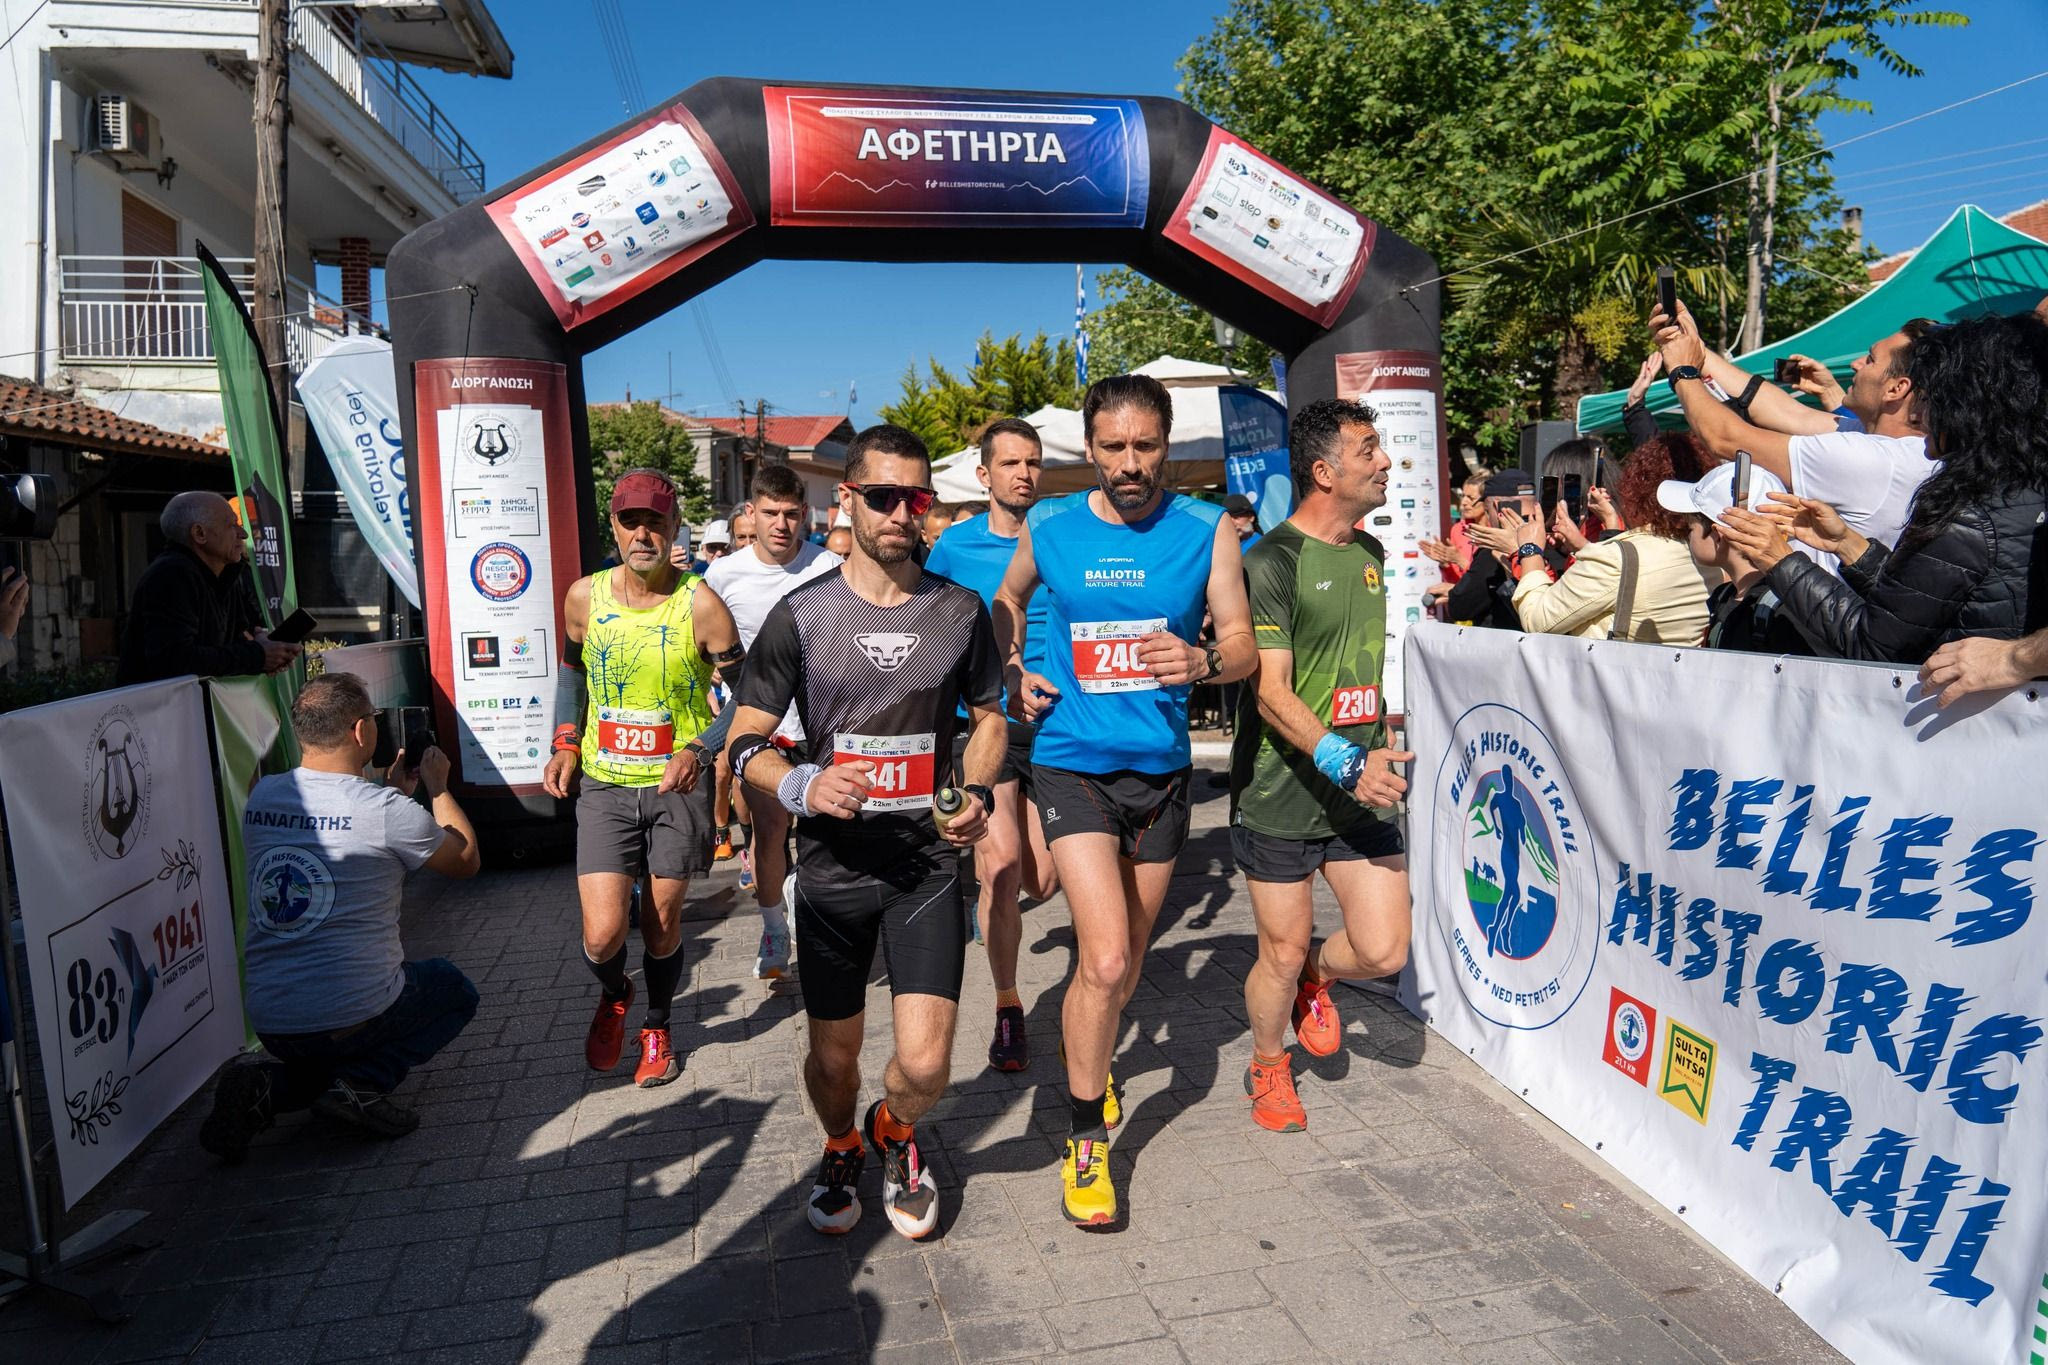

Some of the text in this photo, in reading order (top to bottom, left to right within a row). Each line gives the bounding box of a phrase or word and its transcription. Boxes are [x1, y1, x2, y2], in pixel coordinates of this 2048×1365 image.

[857, 127, 1068, 163] ΑΦΕΤΗΡΙΑ
[939, 181, 1006, 190] BELLESHISTORICTRAIL
[1239, 199, 1262, 217] step
[451, 376, 533, 390] ΔΙΟΡΓΑΝΩΣΗ
[1371, 366, 1430, 377] ΔΙΟΡΓΑΝΩΣΗ
[1393, 435, 1417, 444] CTP
[501, 505, 536, 513] ΣΙΝΤΙΚΗΣ
[1085, 570, 1145, 580] BALIOTIS
[493, 590, 523, 602] PROTECTION
[468, 700, 486, 708] ΕΡΤ
[502, 698, 521, 706] ΕΡΤ
[1337, 688, 1376, 719] 230
[615, 727, 656, 752] 329
[1450, 730, 1579, 855] BELLES HISTORIC TRAIL
[245, 810, 352, 830] ΠΑΝΑΓΙΩΤΗΣ
[271, 851, 307, 867] HISTORIC
[305, 863, 326, 885] TRAIL
[1667, 768, 2046, 948] BELLES
[153, 899, 203, 969] 1941
[1452, 926, 1482, 983] SERRES
[1515, 977, 1561, 1007] PETRITSI
[1606, 860, 2044, 1125] HISTORIC
[1674, 1036, 1708, 1064] SULTA
[1675, 1053, 1705, 1079] NITSA
[1731, 1051, 2012, 1308] TRAIL
